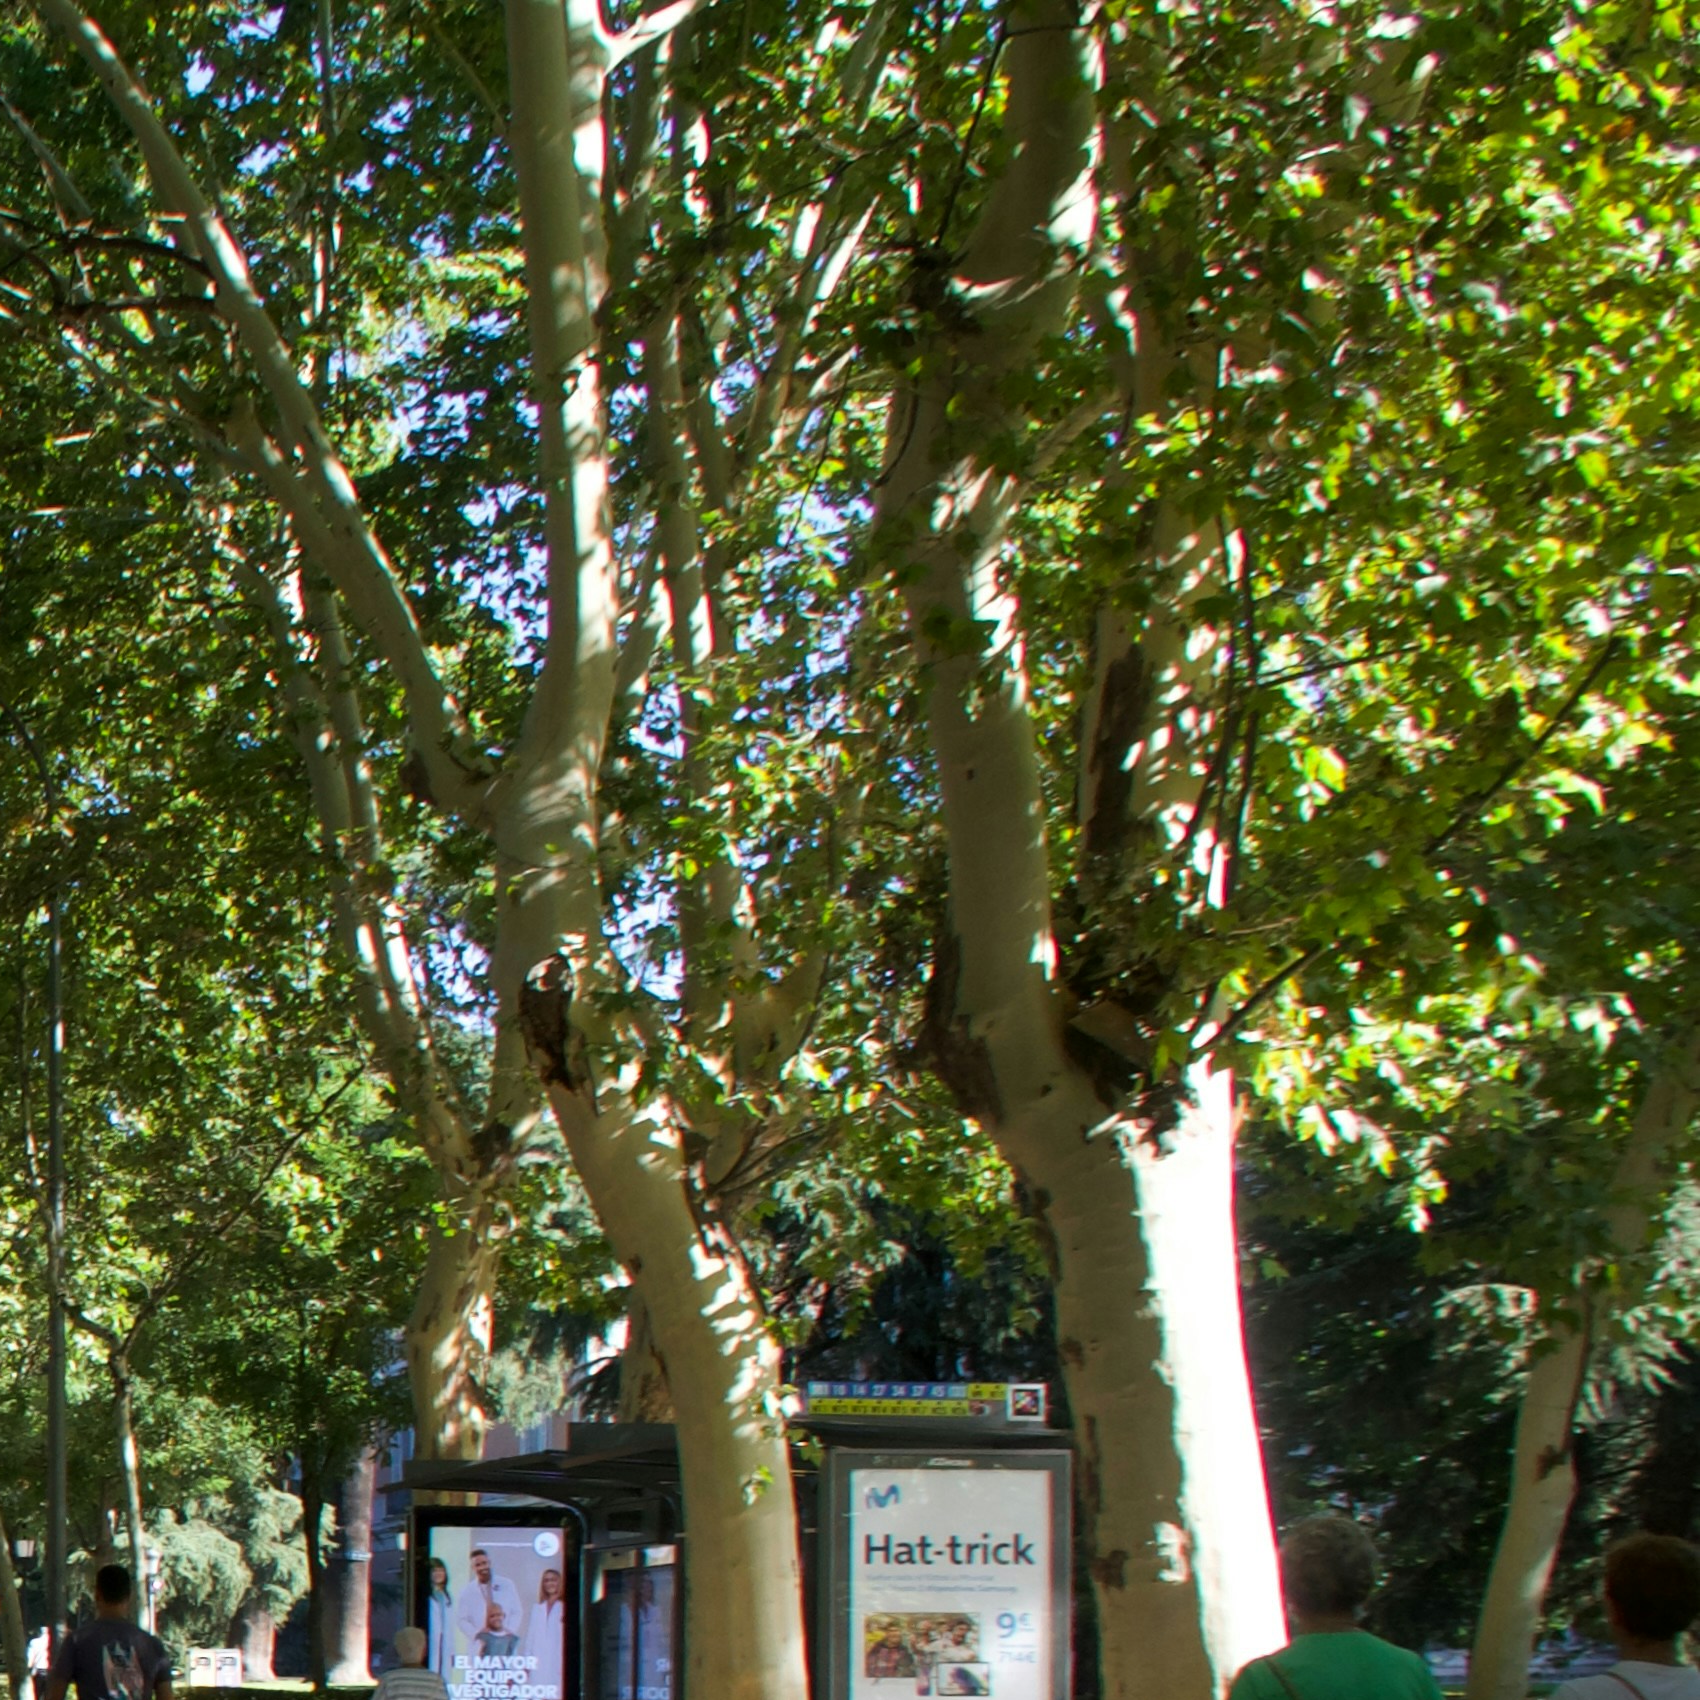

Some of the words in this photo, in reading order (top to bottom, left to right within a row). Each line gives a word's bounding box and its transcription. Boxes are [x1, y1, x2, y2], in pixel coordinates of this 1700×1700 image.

[864, 1533, 1035, 1565] Hat-trick
[455, 1655, 471, 1668] EL
[474, 1655, 537, 1669] MAYOR
[466, 1670, 527, 1684] EQUIPO
[447, 1684, 557, 1698] VESTIGADOR
